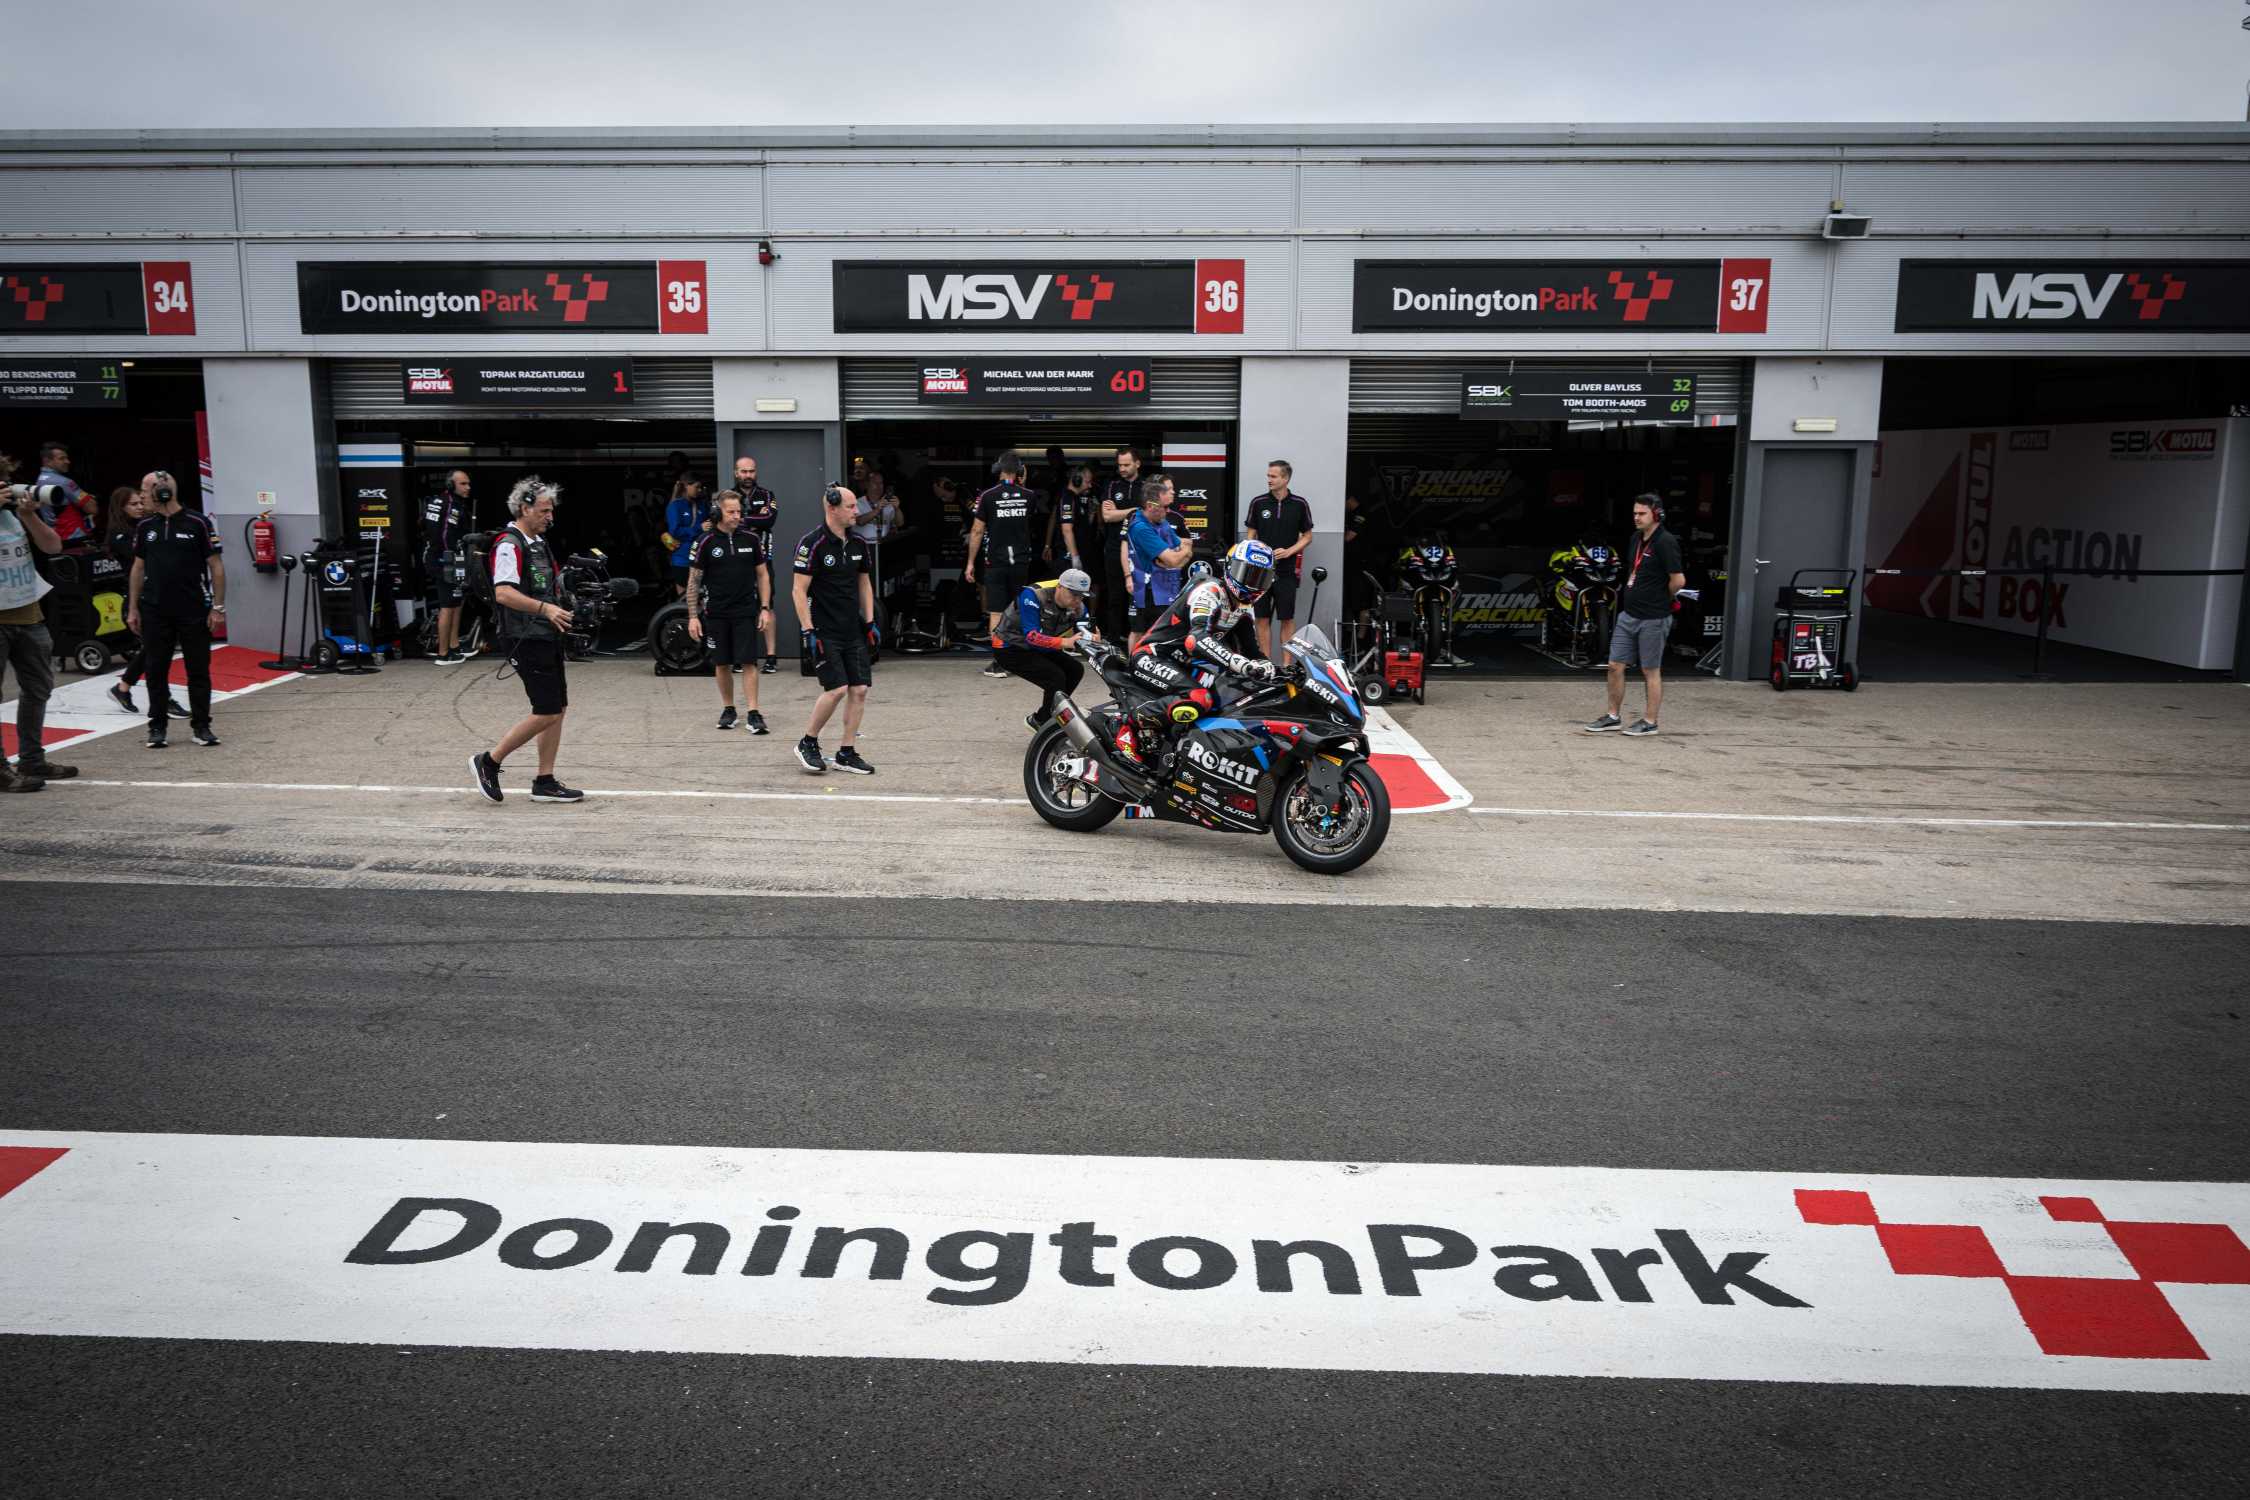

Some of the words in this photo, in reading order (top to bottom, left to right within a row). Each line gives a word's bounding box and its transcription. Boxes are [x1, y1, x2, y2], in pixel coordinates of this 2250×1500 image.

[153, 281, 188, 313] 34
[668, 281, 701, 313] 35
[908, 274, 1053, 320] MSV
[1205, 280, 1238, 313] 36
[1392, 287, 1599, 317] DoningtonPark
[1730, 278, 1763, 311] 37
[1972, 273, 2125, 319] MSV
[341, 289, 539, 318] DoningtonPark
[101, 366, 118, 378] 11
[408, 368, 452, 379] SBK
[480, 371, 517, 379] TOPRAK
[518, 371, 585, 379] RAZGATLIOGLU
[923, 368, 969, 379] SBK
[411, 380, 452, 390] MOTUL
[613, 371, 628, 392] 1
[926, 380, 967, 390] MOTUL
[1110, 370, 1145, 392] 60
[1569, 383, 1602, 391] OLIVER
[1604, 383, 1642, 391] BAYLISS
[1673, 379, 1692, 392] 32
[2, 386, 37, 394] FILIPPO
[39, 386, 74, 394] FARIOLI
[101, 386, 119, 399] 77
[1468, 385, 1513, 397] SBK
[1562, 399, 1583, 407] TOM
[1585, 399, 1647, 407] BOOTH-AMOS
[1670, 400, 1689, 412] 69
[2168, 432, 2214, 449] MOTUL
[1416, 470, 1512, 482] TRIUMPH
[1408, 482, 1505, 497] RACING
[1424, 547, 1441, 558] 32
[1592, 547, 1608, 558] 69
[2002, 526, 2143, 583] ACTION
[1459, 593, 1541, 609] TRIUM
[1999, 577, 2069, 628] BOX
[1223, 805, 1257, 820] OUTDO
[345, 1195, 1814, 1309] DoningtonPark
